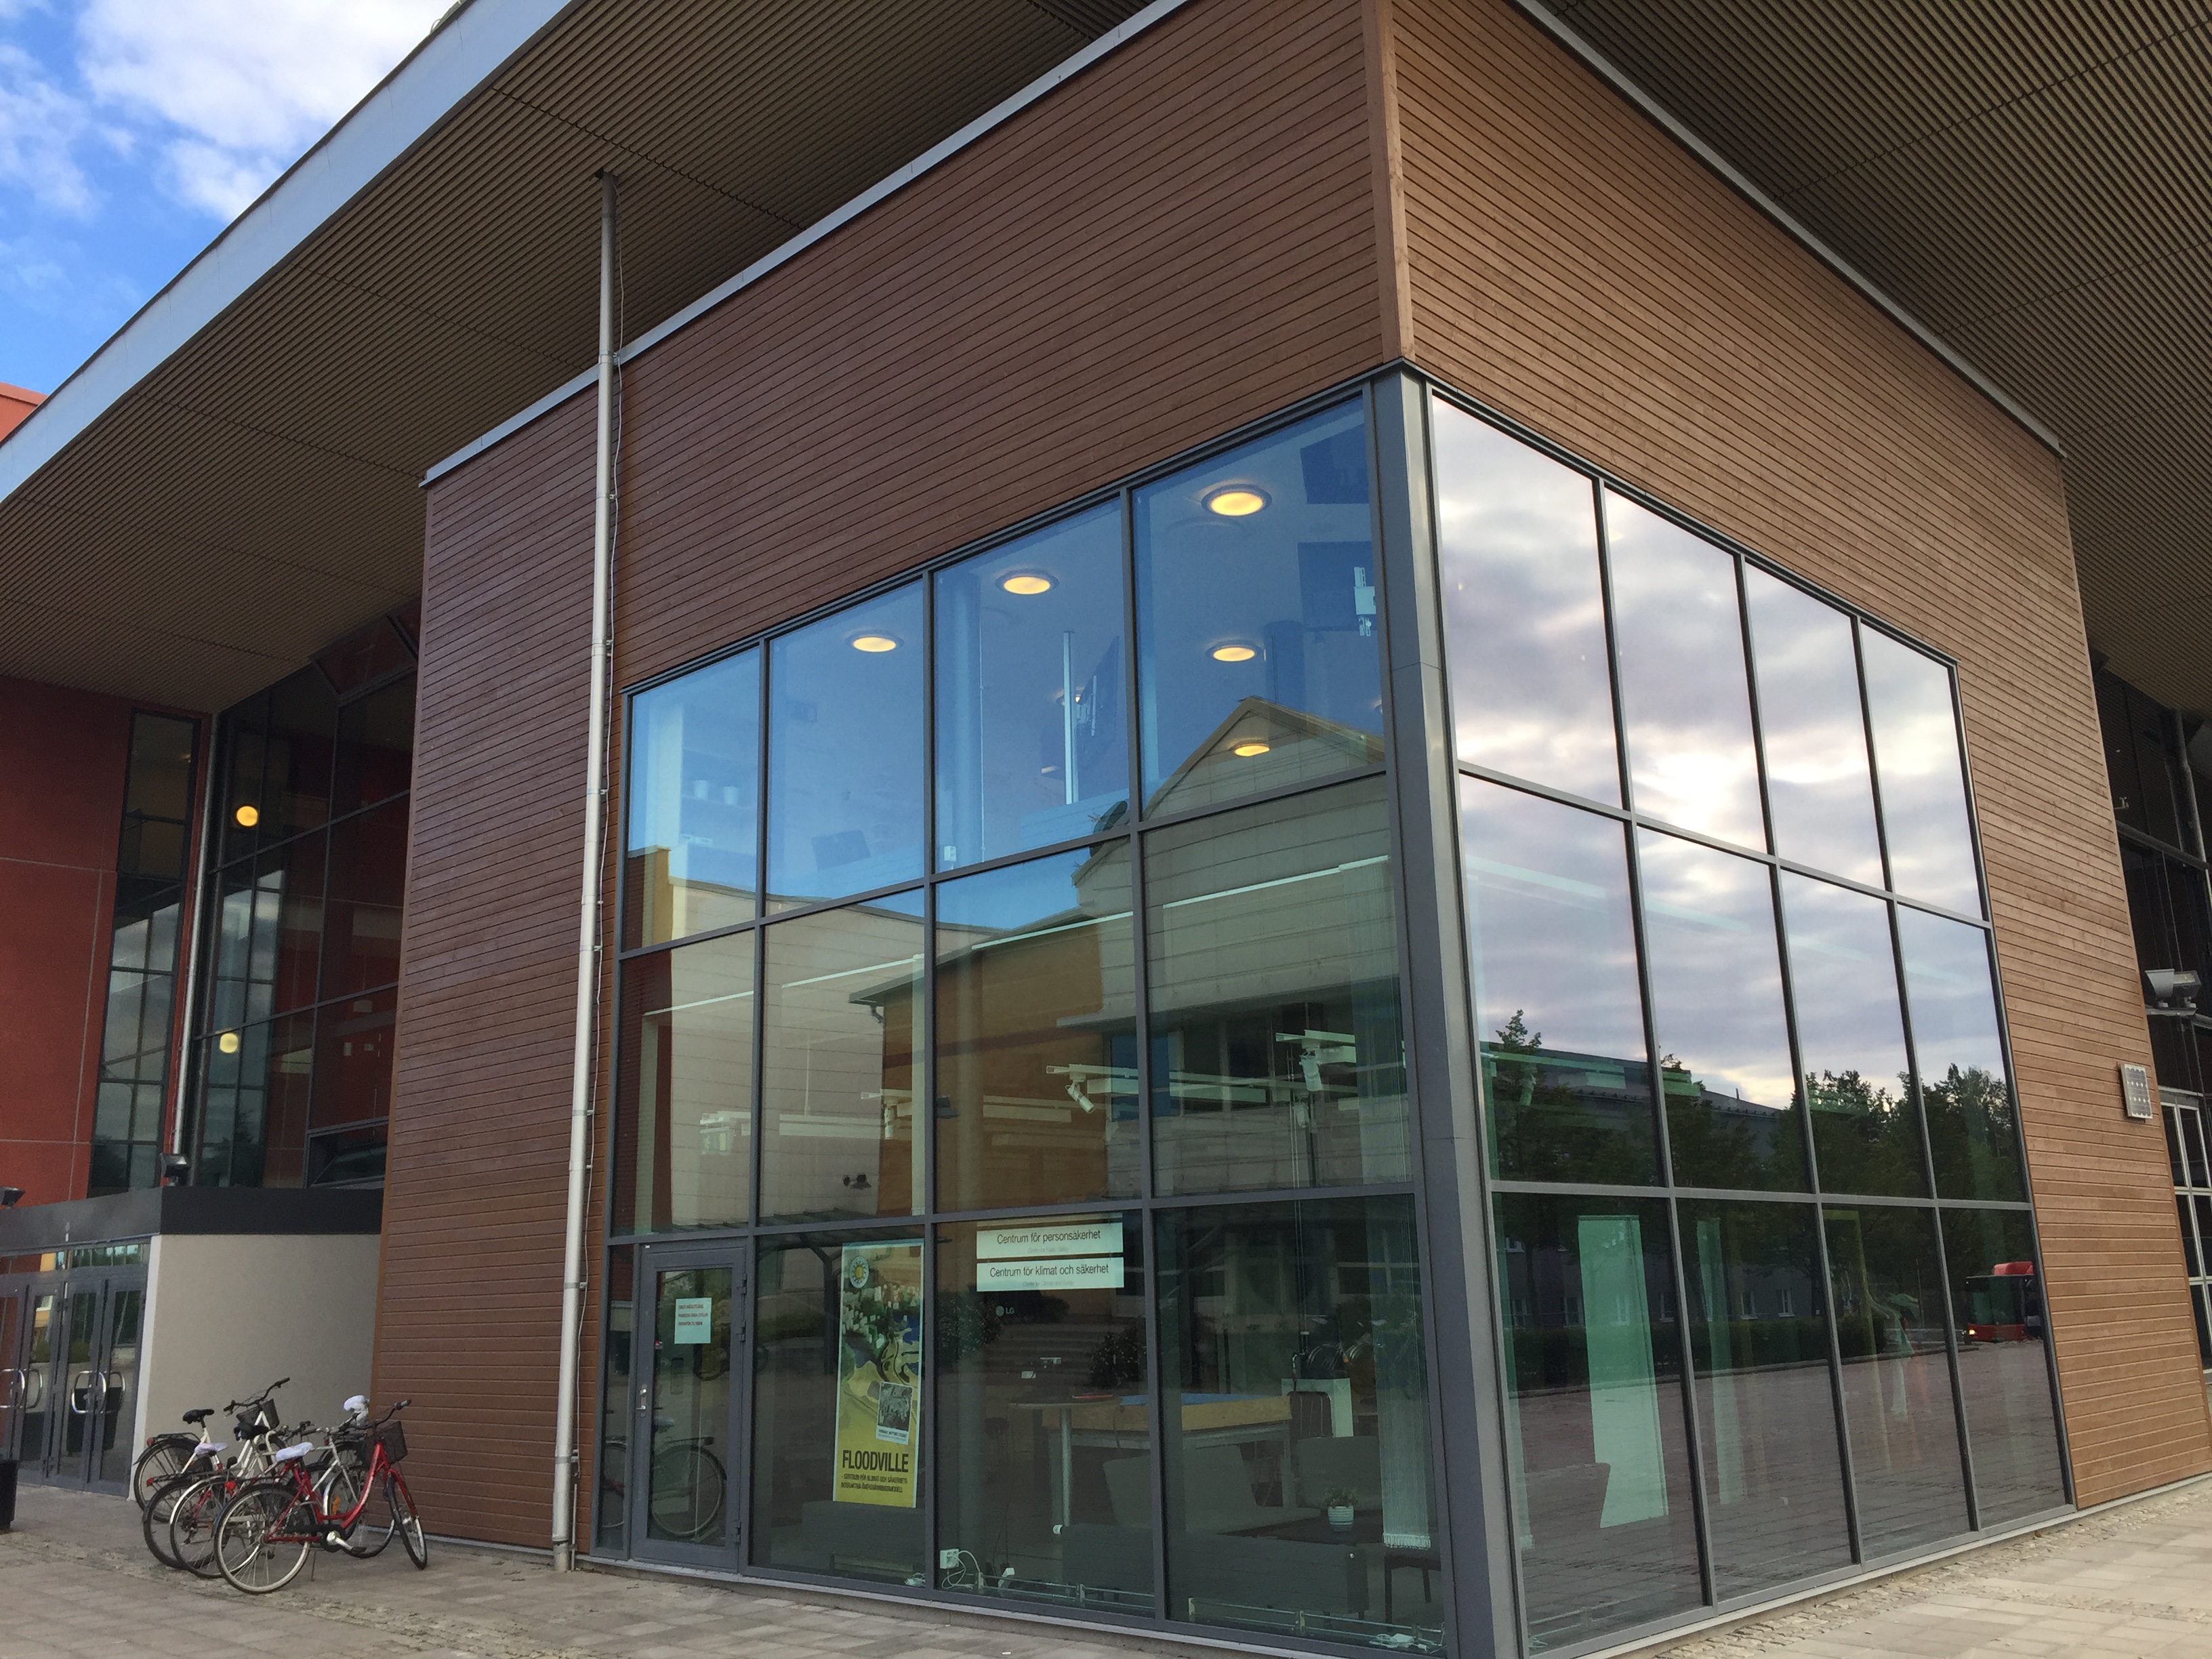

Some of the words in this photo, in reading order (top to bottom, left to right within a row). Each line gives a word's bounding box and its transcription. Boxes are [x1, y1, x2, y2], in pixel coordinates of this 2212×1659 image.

[997, 1233, 1029, 1244] Centrum
[1031, 1232, 1041, 1242] för
[1042, 1229, 1101, 1244] personsäkerhet
[989, 1267, 1021, 1277] Centrum
[1023, 1265, 1033, 1276] för
[1036, 1265, 1058, 1275] klimat
[1059, 1265, 1073, 1275] och
[1076, 1263, 1109, 1274] säkerhet
[842, 1450, 909, 1473] FLOODVILLE
